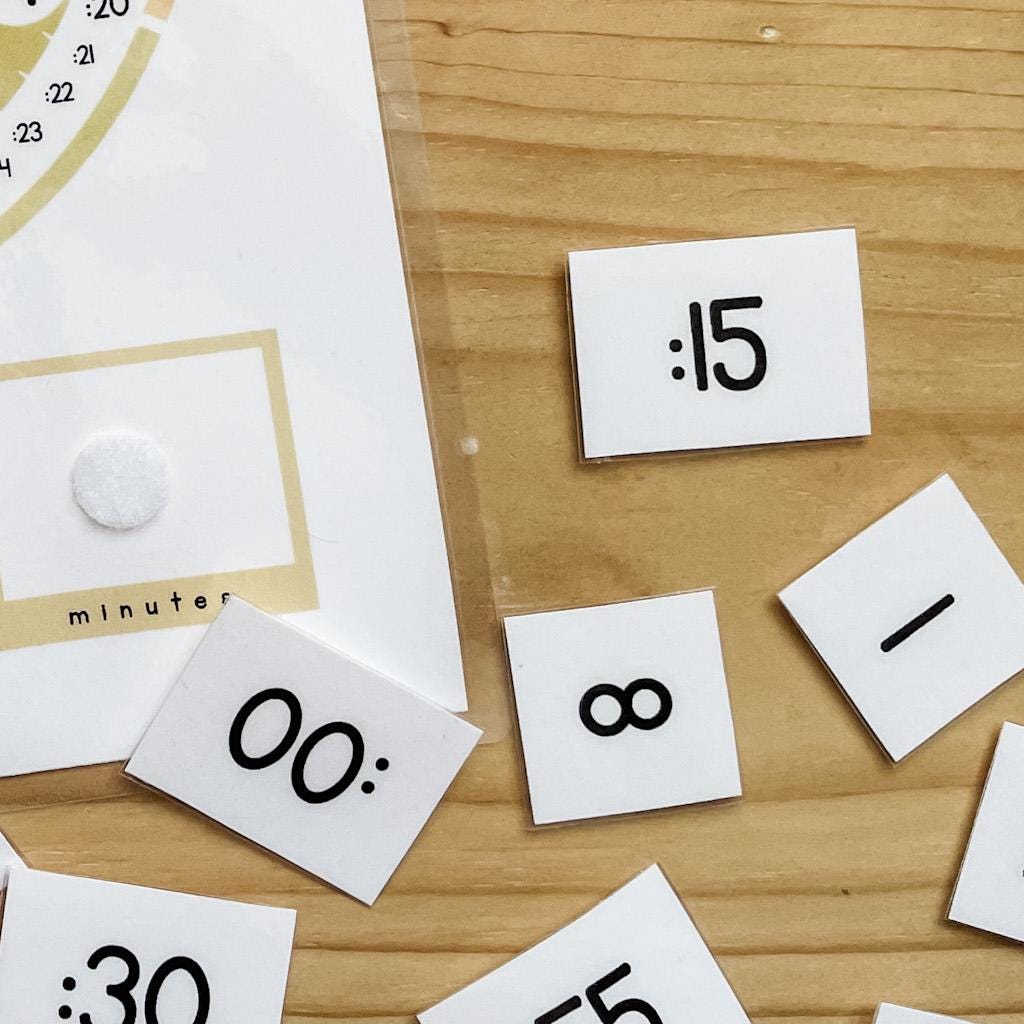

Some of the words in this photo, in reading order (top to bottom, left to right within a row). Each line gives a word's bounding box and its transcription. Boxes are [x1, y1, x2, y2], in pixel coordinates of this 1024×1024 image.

[72, 43, 95, 66] :21
[44, 81, 76, 104] :22
[12, 120, 43, 144] :23
[668, 295, 768, 392] :15
[578, 677, 674, 738] 8
[228, 687, 390, 805] :00
[57, 944, 211, 1024] :30
